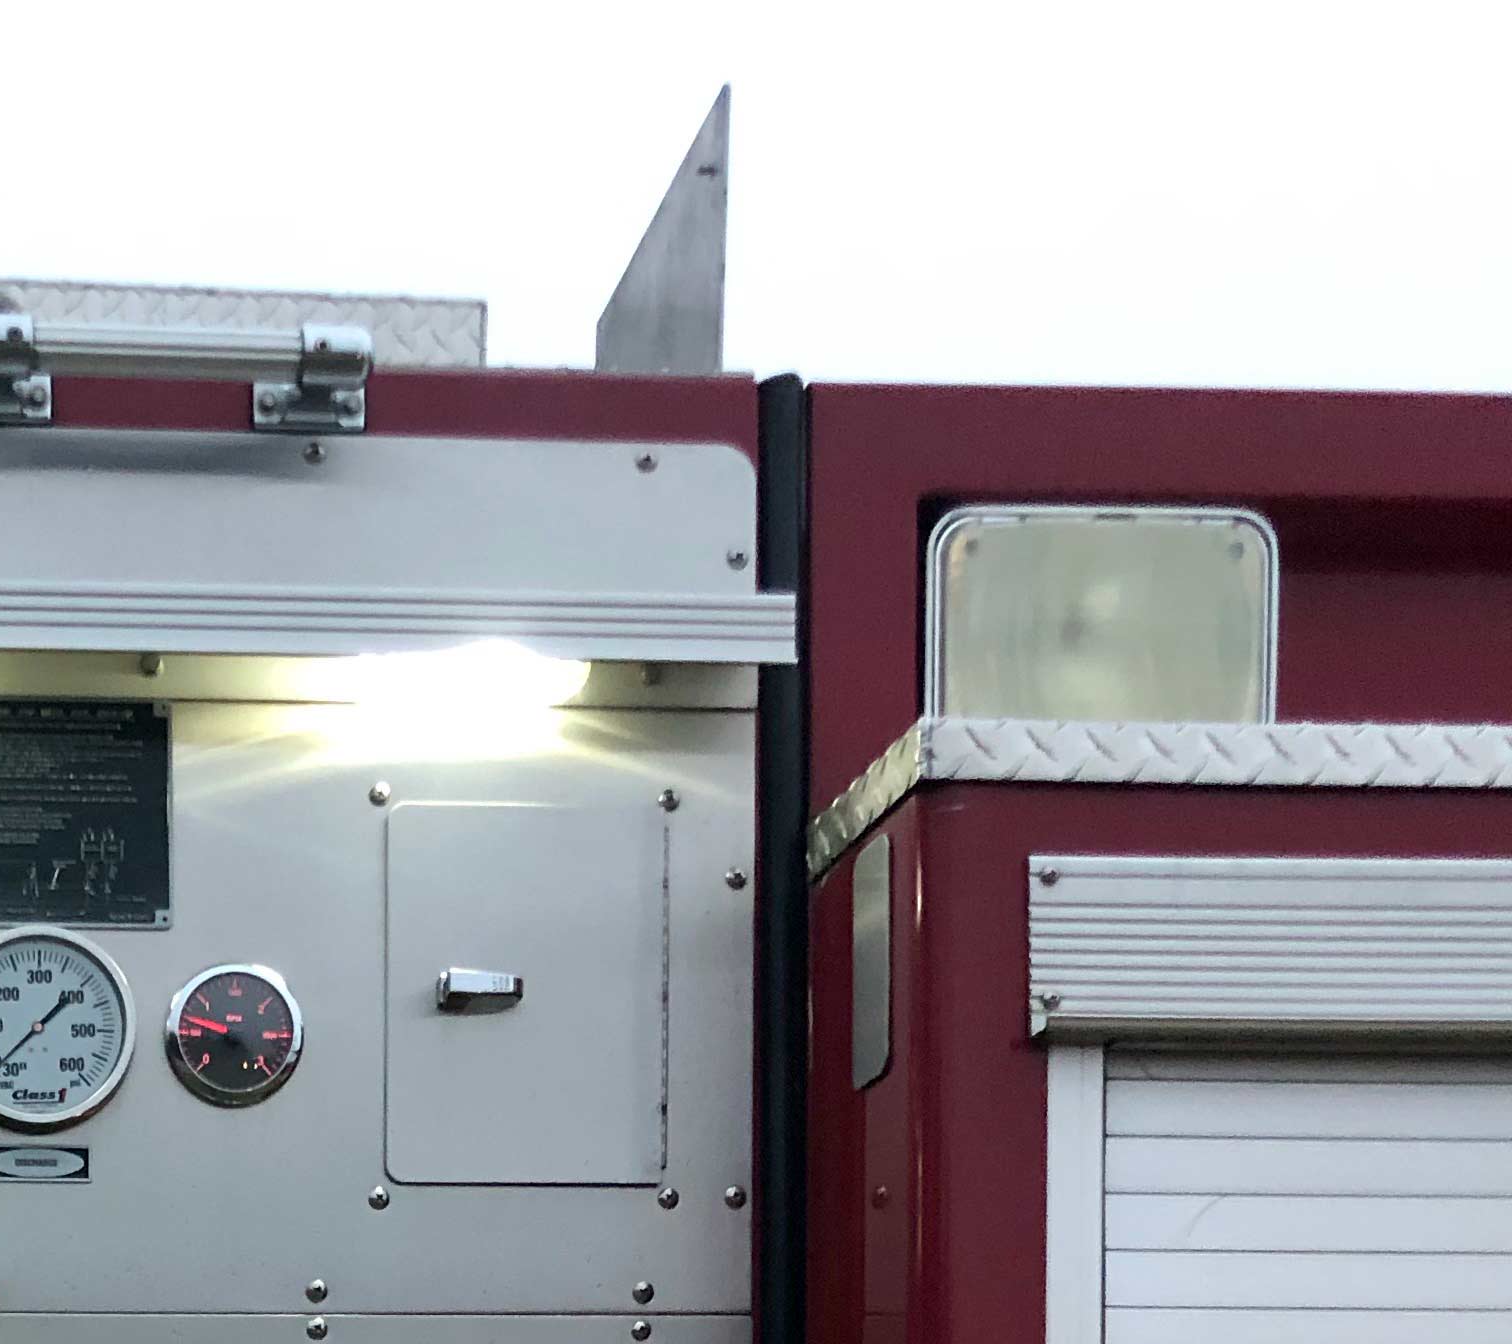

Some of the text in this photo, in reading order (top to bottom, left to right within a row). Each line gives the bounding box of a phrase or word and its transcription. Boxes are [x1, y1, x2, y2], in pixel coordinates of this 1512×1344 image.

[27, 970, 52, 983] 300
[71, 1024, 95, 1037] 500
[60, 1058, 84, 1071] 600
